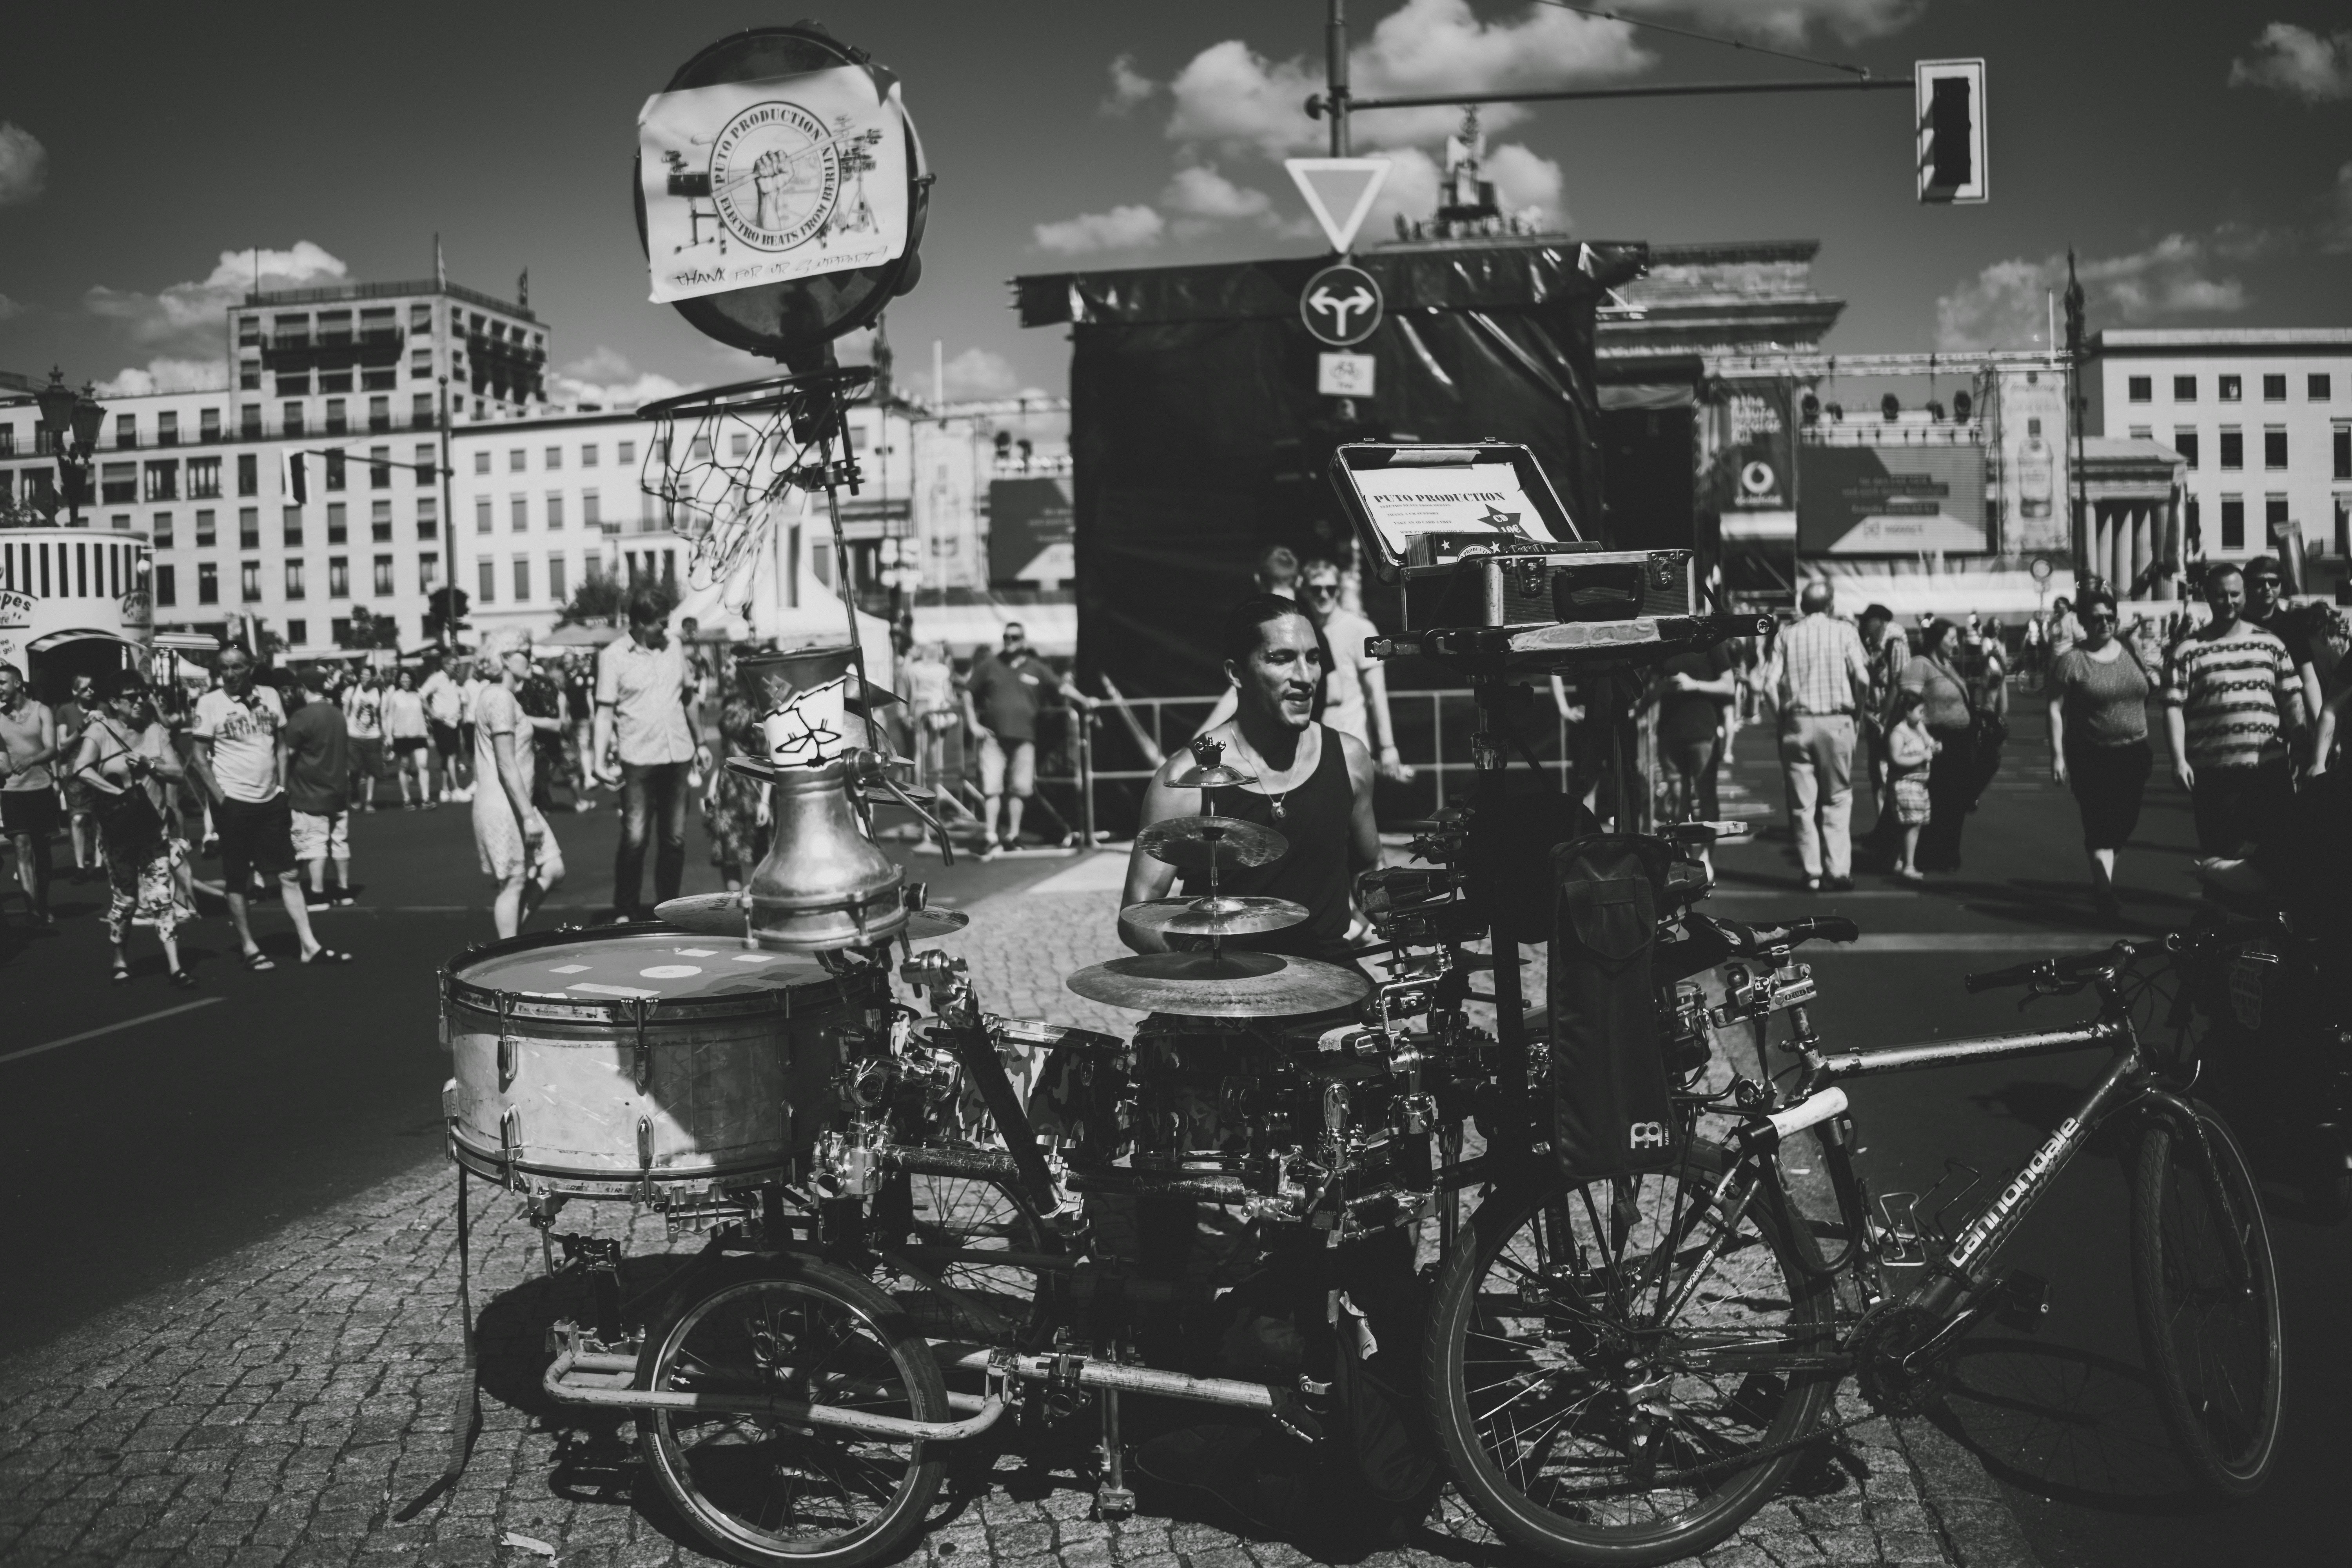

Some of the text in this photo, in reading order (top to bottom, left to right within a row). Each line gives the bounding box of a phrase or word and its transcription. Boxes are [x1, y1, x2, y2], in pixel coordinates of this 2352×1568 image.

[715, 108, 822, 185] PUTO PRODUCTION
[720, 146, 835, 246] ELECTRO BEATS FROM BERLIN
[1372, 492, 1506, 503] PUTO PRODUCTION
[1493, 514, 1508, 523] CD
[1500, 524, 1521, 533] 10€
[1789, 990, 1805, 999] TAMA
[1948, 1117, 2080, 1267] cannondale
[649, 1432, 666, 1472] MARATHO
[684, 1503, 725, 1539] SCHWALBE
